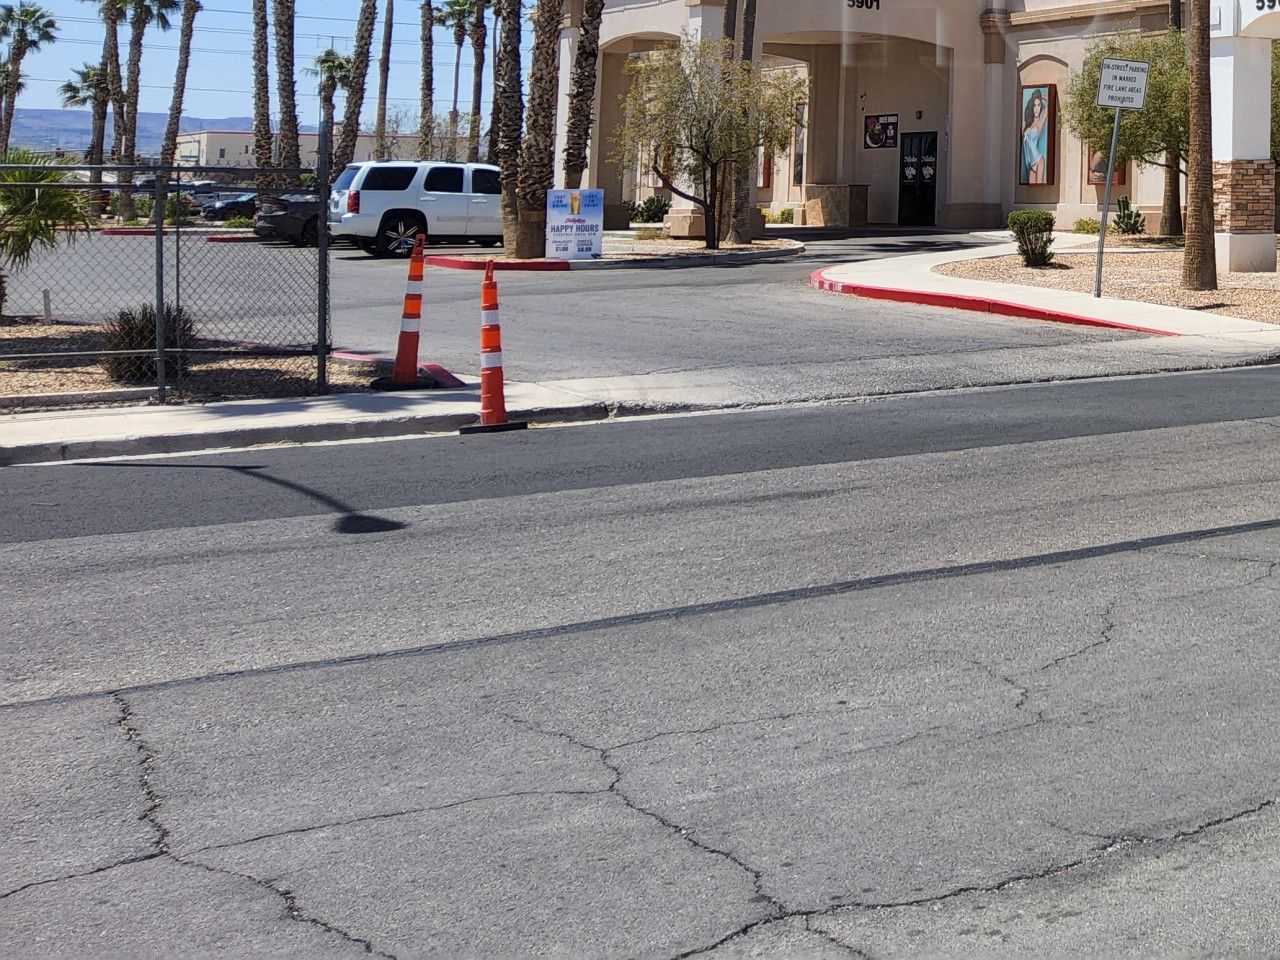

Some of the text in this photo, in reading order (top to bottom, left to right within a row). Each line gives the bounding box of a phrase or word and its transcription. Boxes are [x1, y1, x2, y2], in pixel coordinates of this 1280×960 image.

[1104, 64, 1147, 74] ON-STREET PARKING
[1108, 95, 1134, 103] PROHIBITED
[551, 224, 599, 233] HAPPY HOURS
